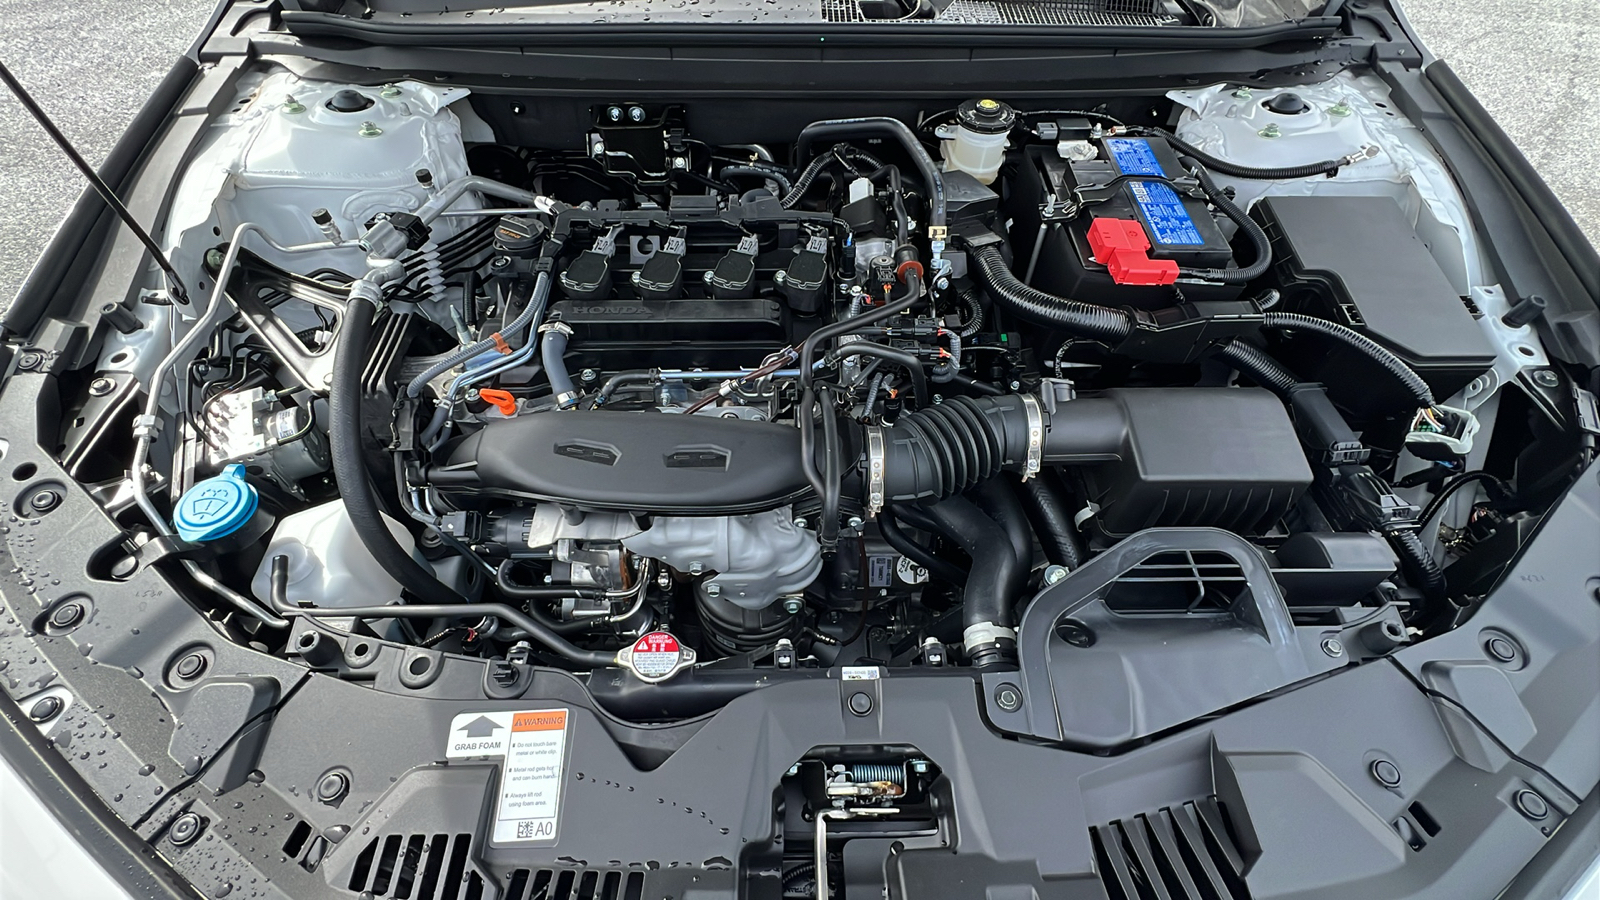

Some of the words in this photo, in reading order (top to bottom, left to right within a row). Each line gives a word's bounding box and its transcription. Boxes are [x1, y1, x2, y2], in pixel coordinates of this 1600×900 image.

[572, 306, 654, 315] HONDA
[524, 717, 563, 726] WARNING
[454, 743, 477, 751] GRAB
[478, 741, 502, 750] FOAM
[534, 821, 553, 837] A0
